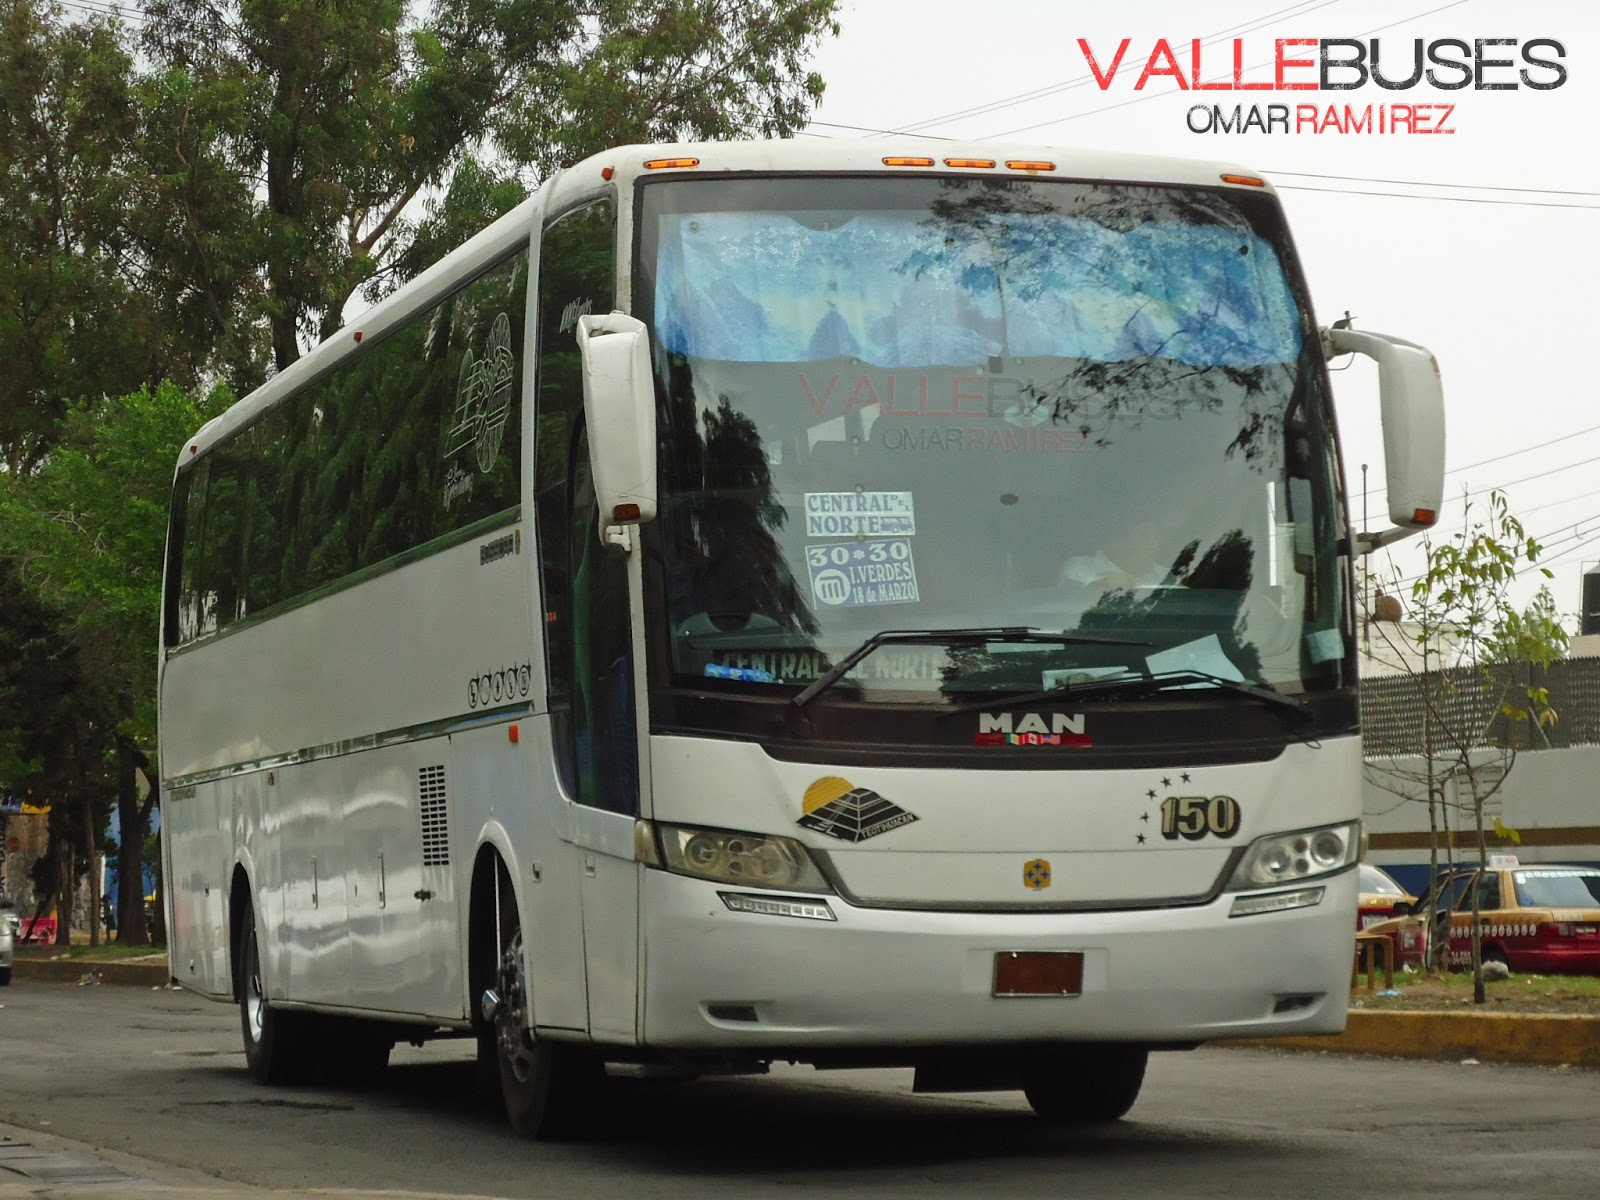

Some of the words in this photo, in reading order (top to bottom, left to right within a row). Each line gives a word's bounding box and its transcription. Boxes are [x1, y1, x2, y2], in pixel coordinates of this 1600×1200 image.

[808, 494, 893, 513] CENTRAL
[810, 516, 880, 534] NORTE
[853, 586, 865, 604] 18
[866, 587, 877, 603] de
[879, 581, 916, 602] MARZO
[979, 712, 1085, 735] MAN
[861, 813, 914, 839] TEOTIHUACAN
[1160, 795, 1241, 841] 150
